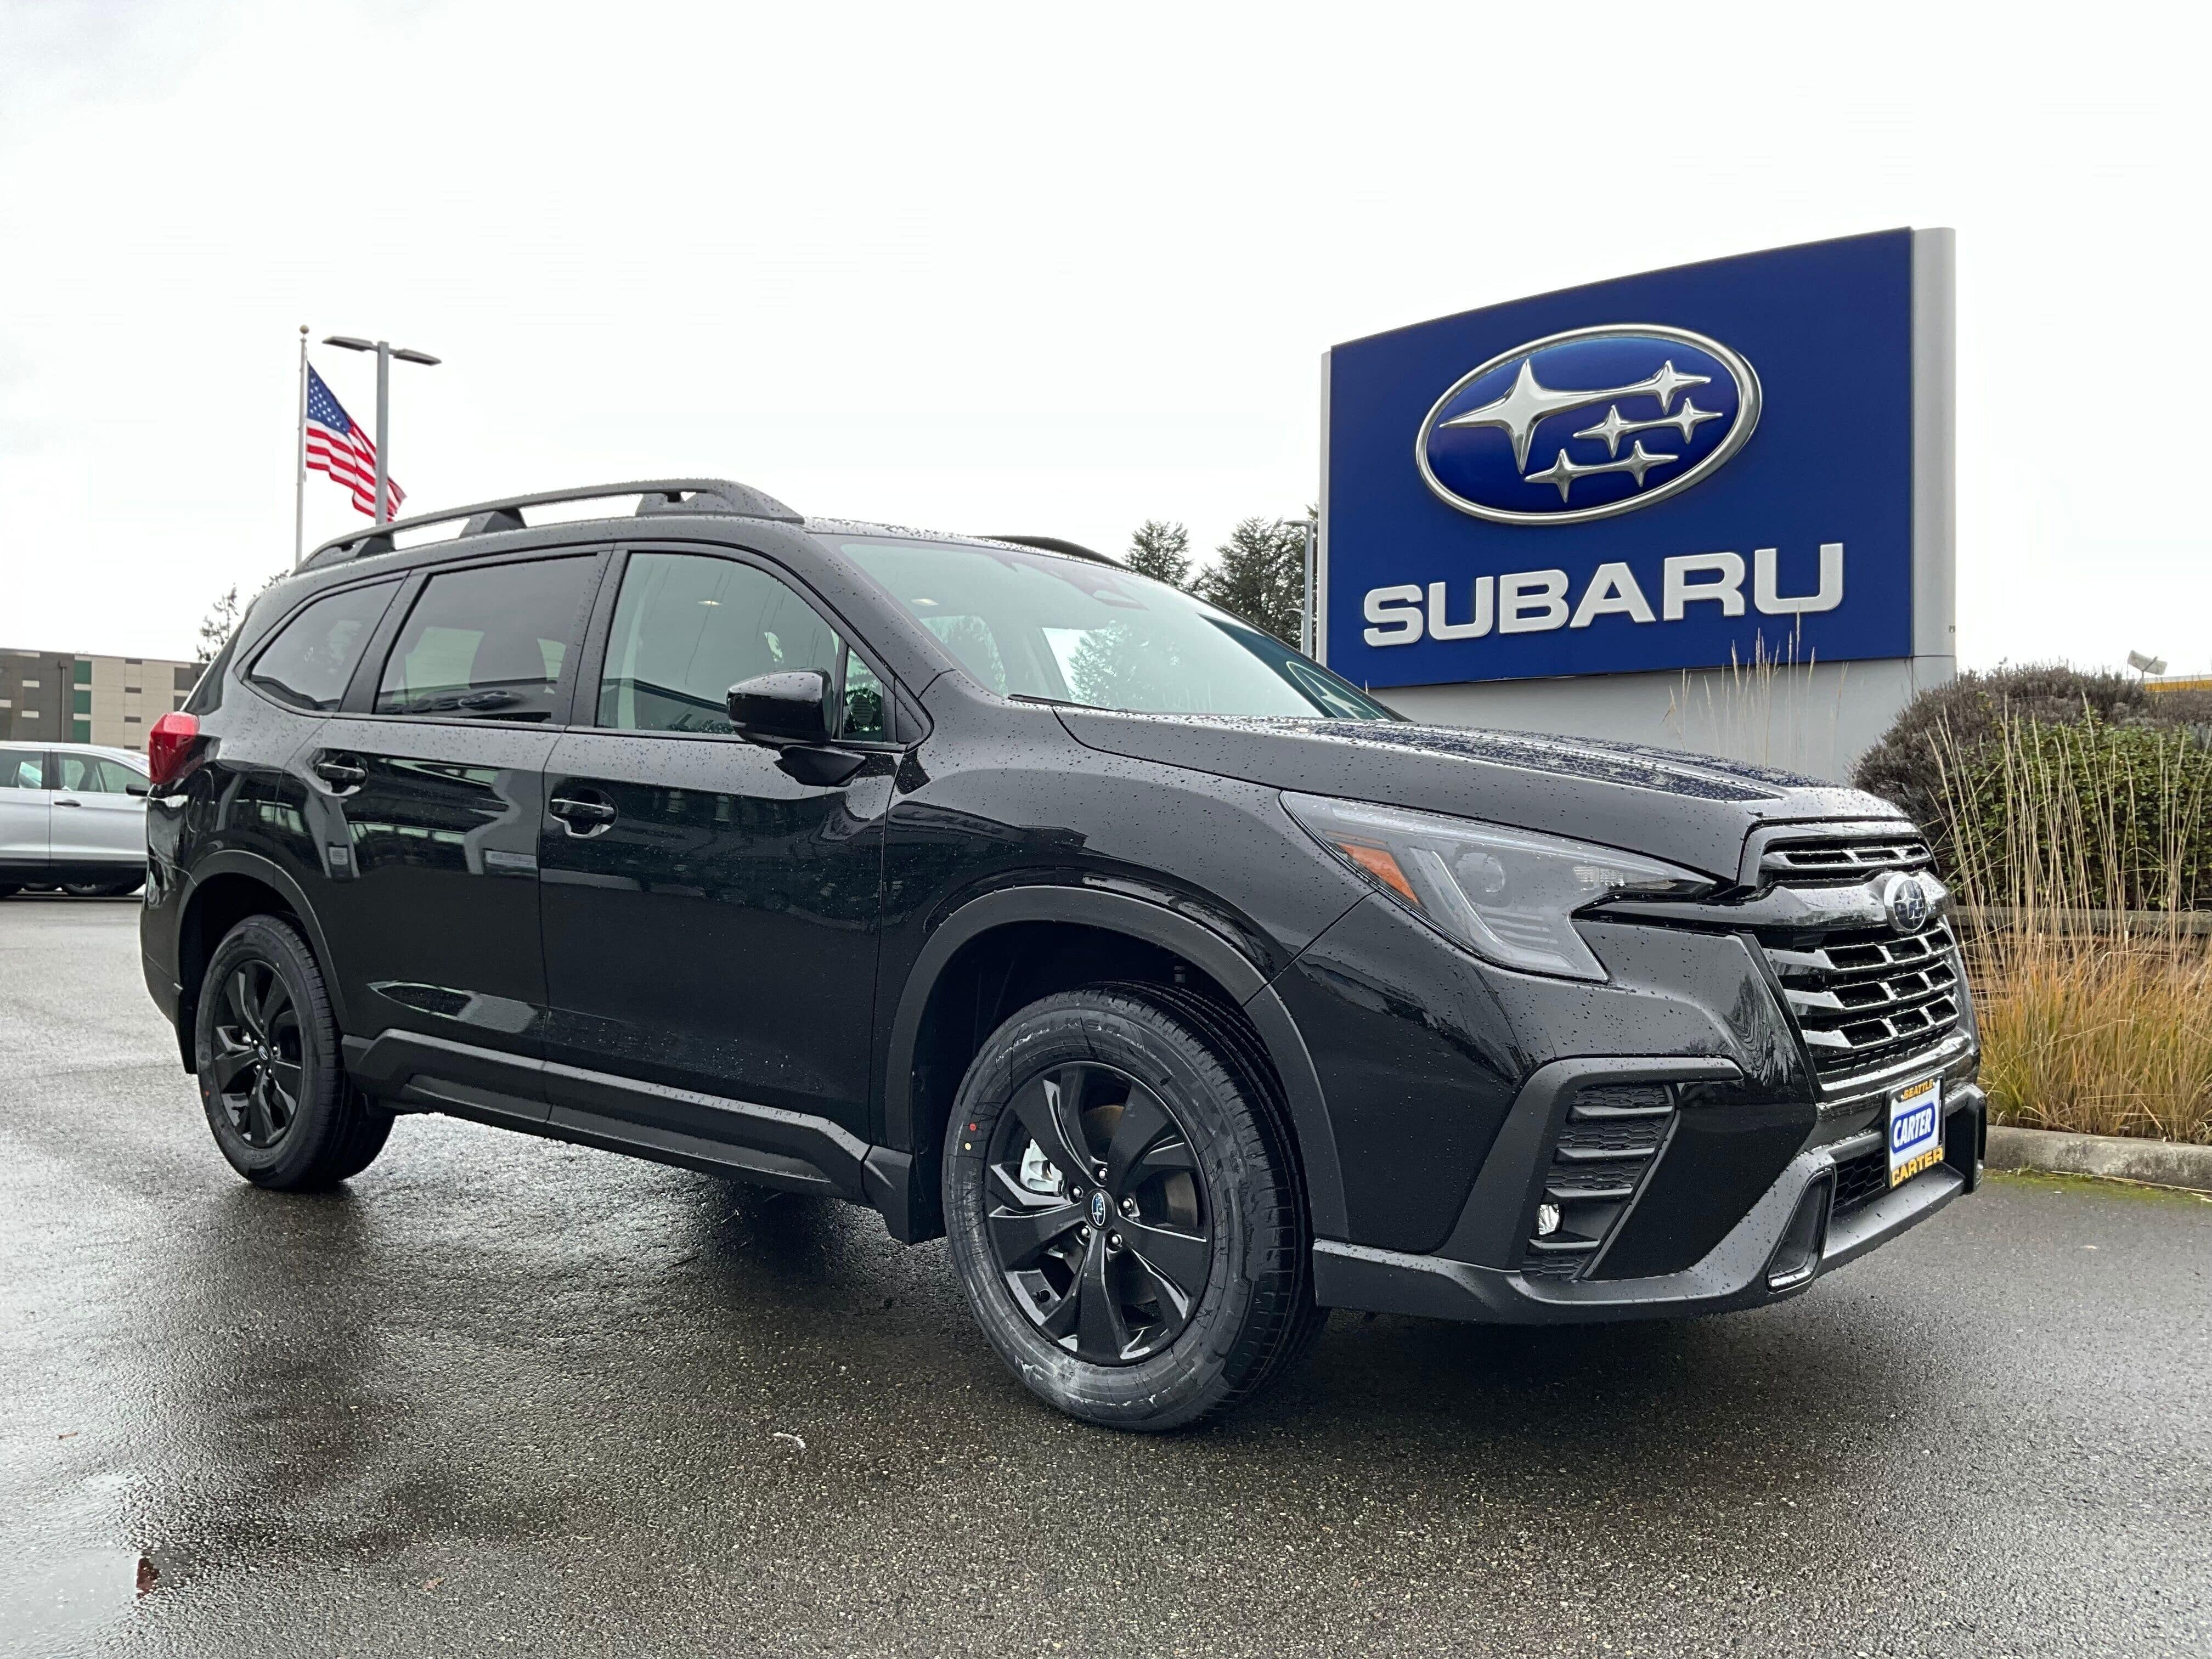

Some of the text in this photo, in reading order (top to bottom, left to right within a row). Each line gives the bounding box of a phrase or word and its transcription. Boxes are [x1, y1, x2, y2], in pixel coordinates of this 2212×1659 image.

[1363, 543, 1843, 647] SUBARU
[1904, 1079, 1933, 1099] SEATTLE
[1893, 1108, 1932, 1148] CARTER
[1892, 1147, 1943, 1186] CARTER
